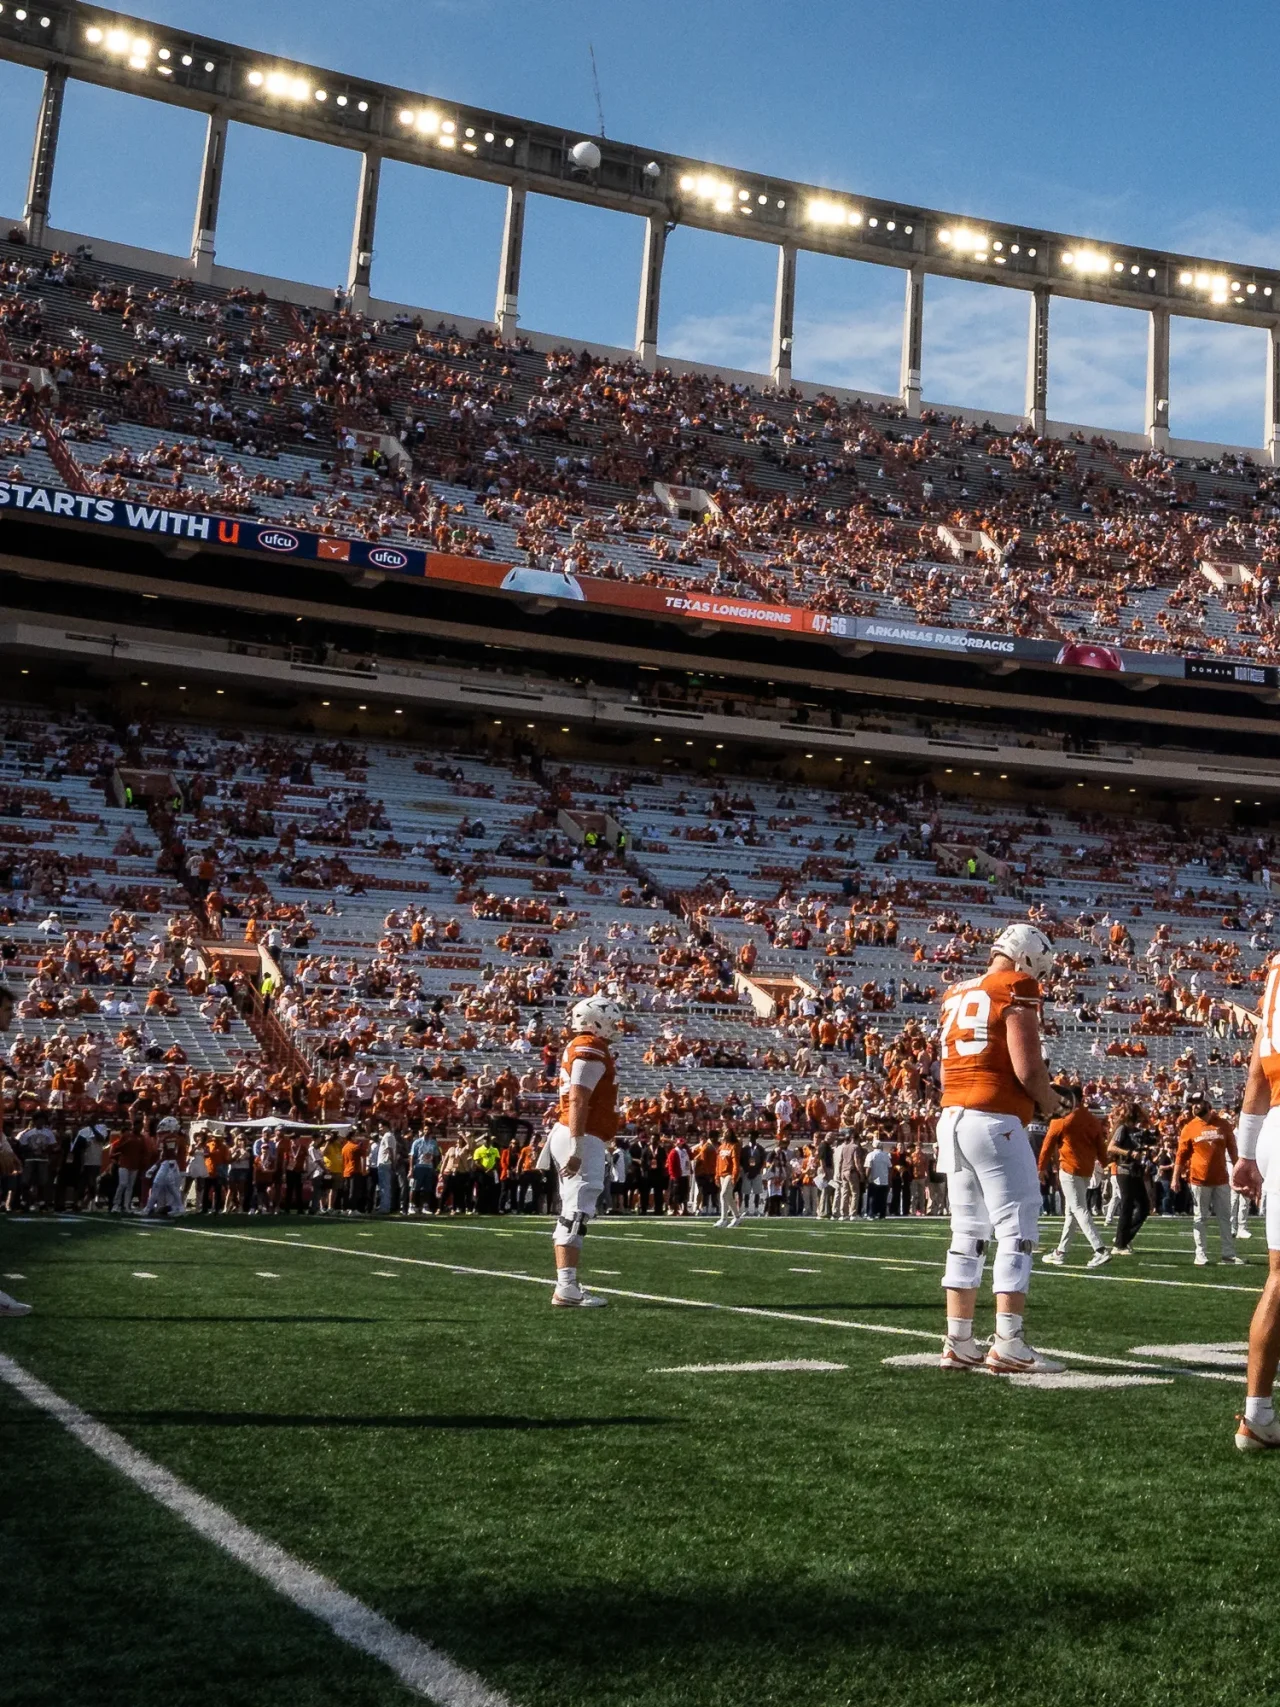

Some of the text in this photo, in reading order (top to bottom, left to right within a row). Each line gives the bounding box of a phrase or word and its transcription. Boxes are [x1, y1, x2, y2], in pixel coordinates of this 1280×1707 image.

[0, 483, 115, 522] STARTS
[125, 503, 210, 539] WITH
[264, 534, 292, 548] ufcu
[374, 551, 401, 564] ufcu
[665, 596, 792, 624] TEXAS LONGHORNS
[811, 614, 847, 635] 47:56
[865, 624, 1015, 653] ARKANSAS RAZORBACKS
[1191, 666, 1232, 676] DOMAIN
[942, 990, 991, 1059] 79
